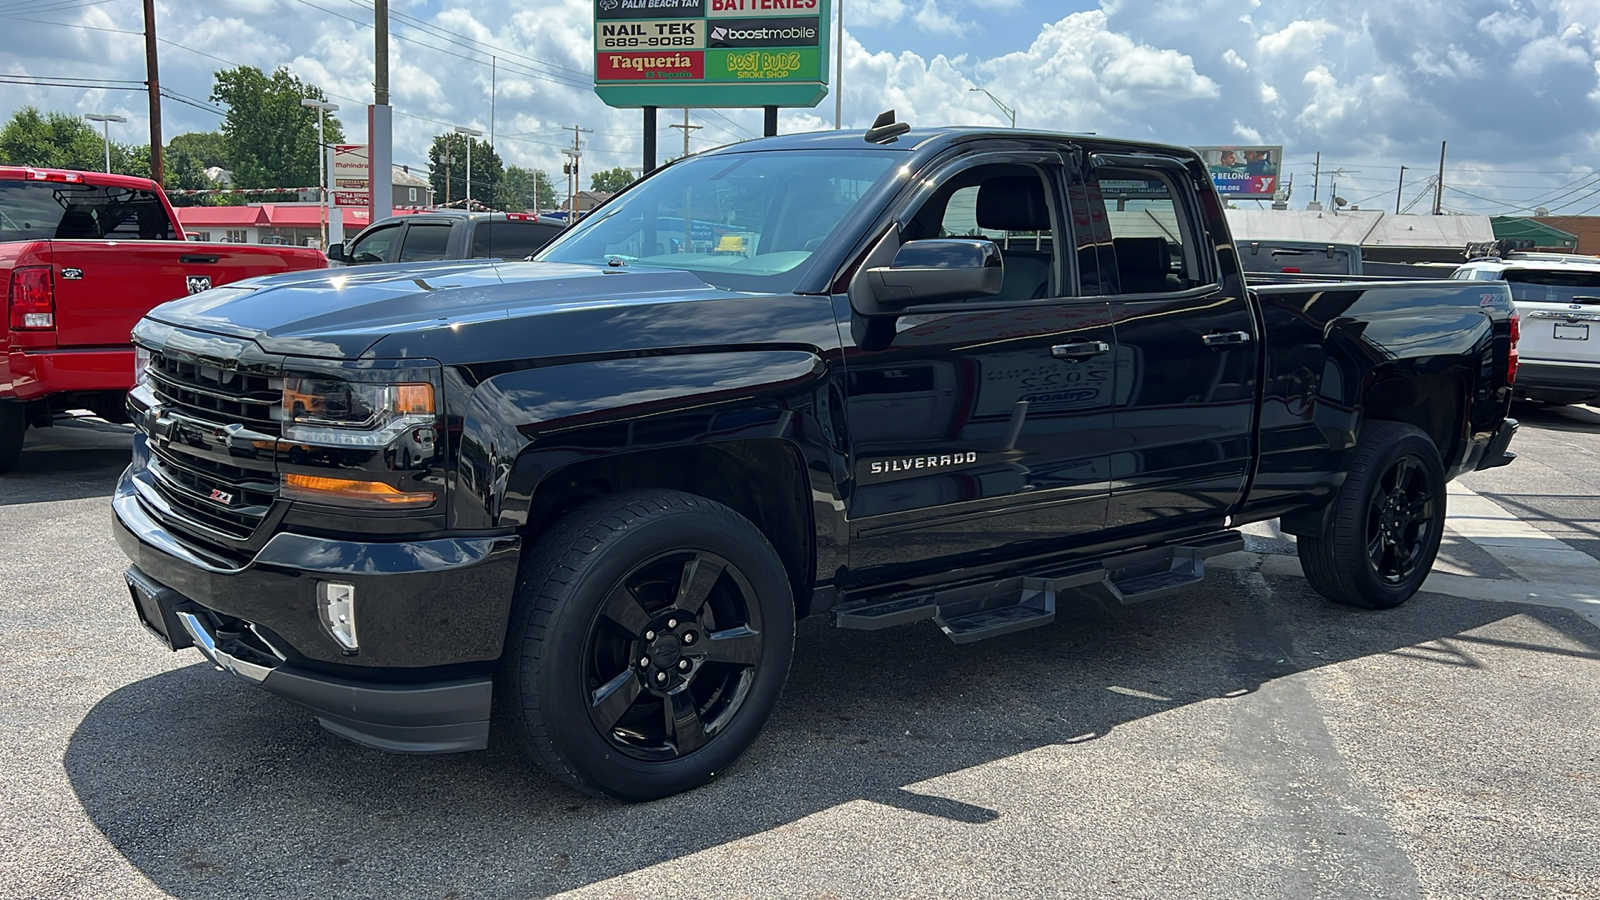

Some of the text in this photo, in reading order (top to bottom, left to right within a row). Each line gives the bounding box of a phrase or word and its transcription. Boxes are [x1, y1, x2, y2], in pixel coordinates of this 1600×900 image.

[621, 0, 645, 8] PALM
[648, 0, 678, 8] BEACH
[712, 0, 816, 11] BATTERIES
[602, 23, 696, 36] NAIL TEK
[728, 26, 815, 39] boostmobile
[604, 36, 695, 47] 689-9088
[1217, 172, 1253, 180] BELONG.
[870, 451, 976, 474] SILVERADO
[210, 488, 233, 504] Z71
